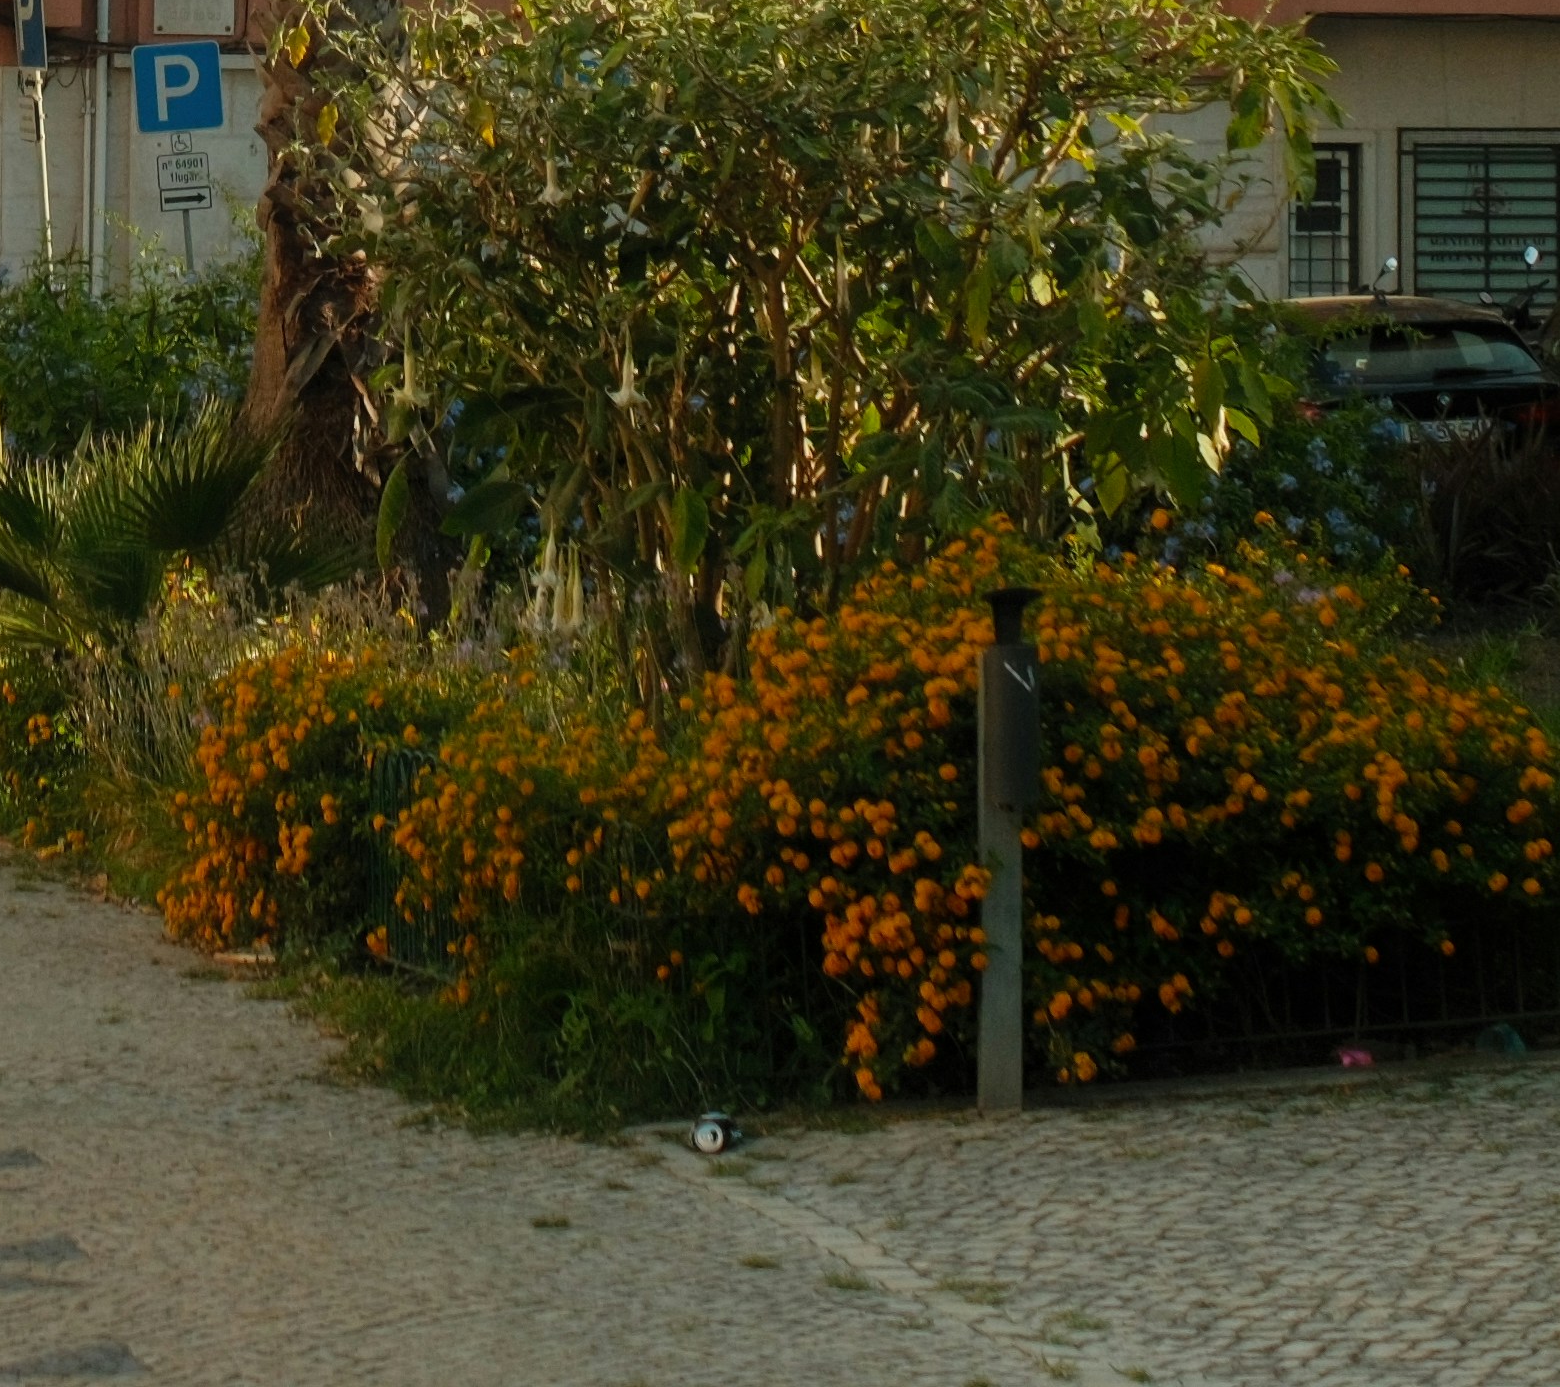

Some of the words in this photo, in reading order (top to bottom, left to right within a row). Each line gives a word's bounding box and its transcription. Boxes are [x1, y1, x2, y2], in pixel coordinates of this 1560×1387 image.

[154, 54, 200, 122] P
[175, 157, 203, 170] 64901
[175, 171, 199, 184] lugar
